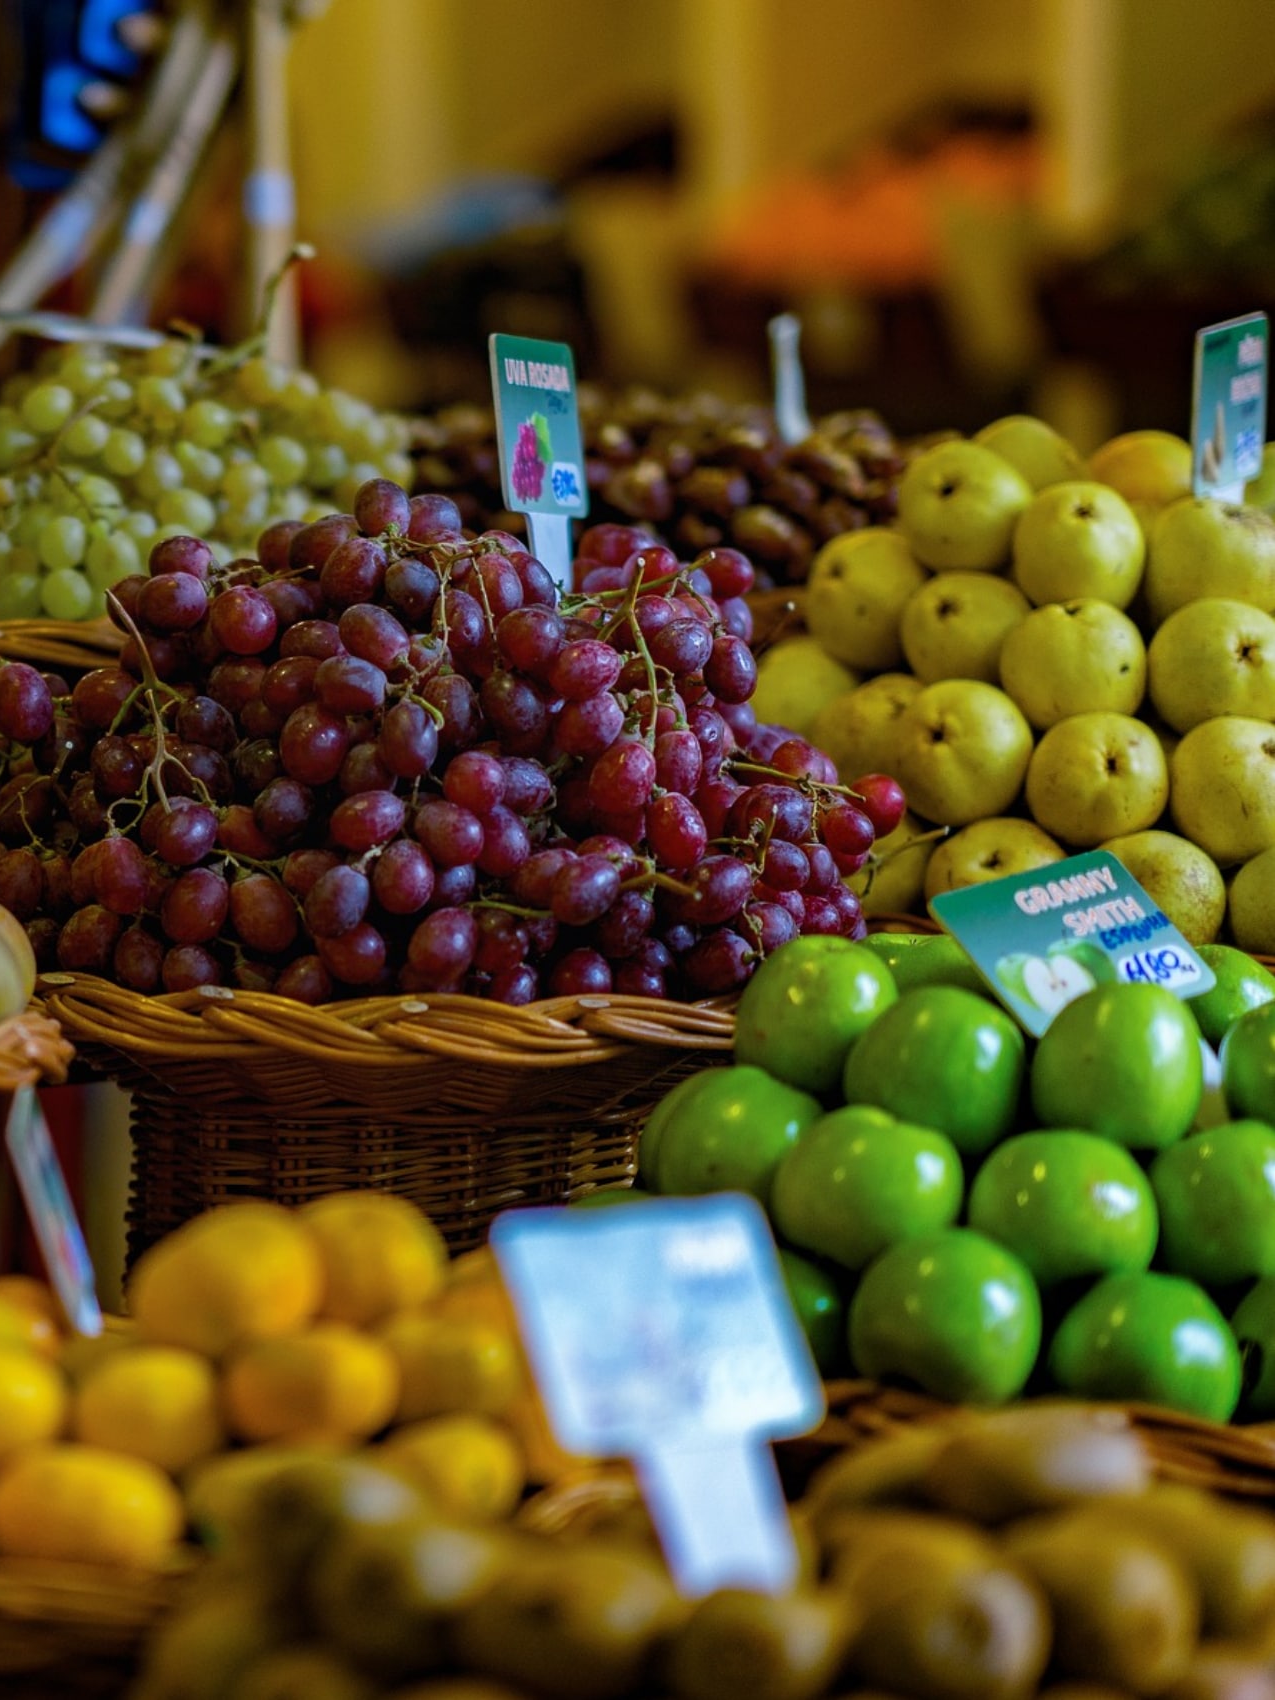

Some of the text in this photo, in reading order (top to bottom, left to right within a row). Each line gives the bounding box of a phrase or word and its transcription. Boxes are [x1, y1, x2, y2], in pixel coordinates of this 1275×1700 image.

[504, 357, 529, 386] UVA
[1013, 865, 1118, 915] GRANNY
[1062, 896, 1146, 937] SMITH
